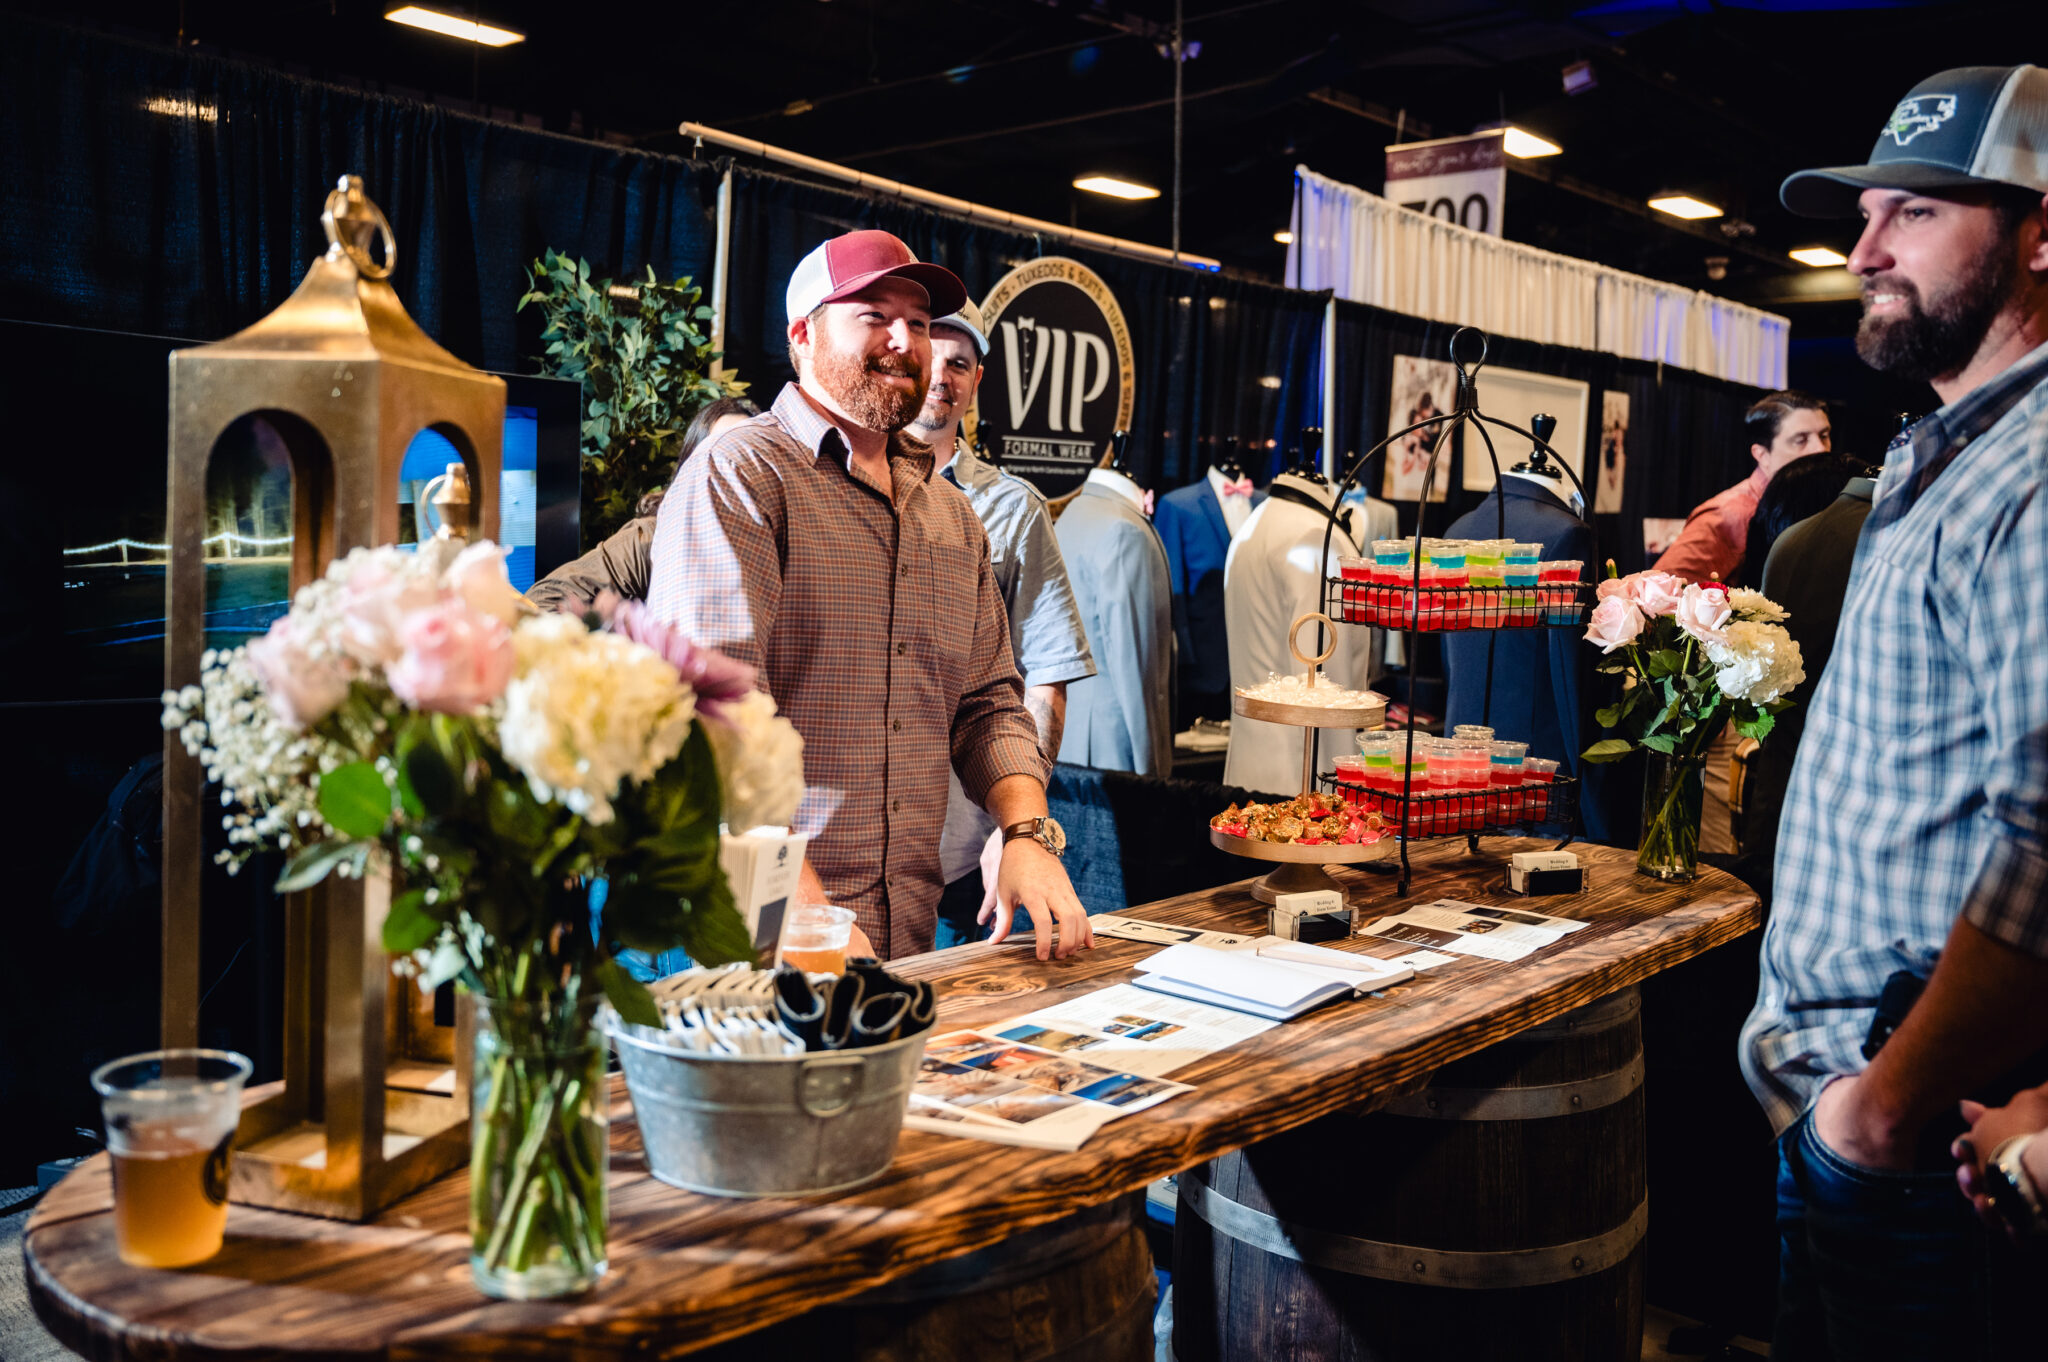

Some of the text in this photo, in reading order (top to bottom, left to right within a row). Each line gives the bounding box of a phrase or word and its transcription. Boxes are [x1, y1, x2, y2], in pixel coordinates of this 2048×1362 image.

[1400, 193, 1488, 233] 00
[983, 286, 1010, 325] SUITS
[1016, 263, 1065, 287] TUXEDOS
[1077, 270, 1103, 301] SUITS
[1107, 302, 1129, 368] TUXEDOS
[1000, 319, 1111, 433] VIP
[1004, 440, 1092, 459] FORMAL WEAR
